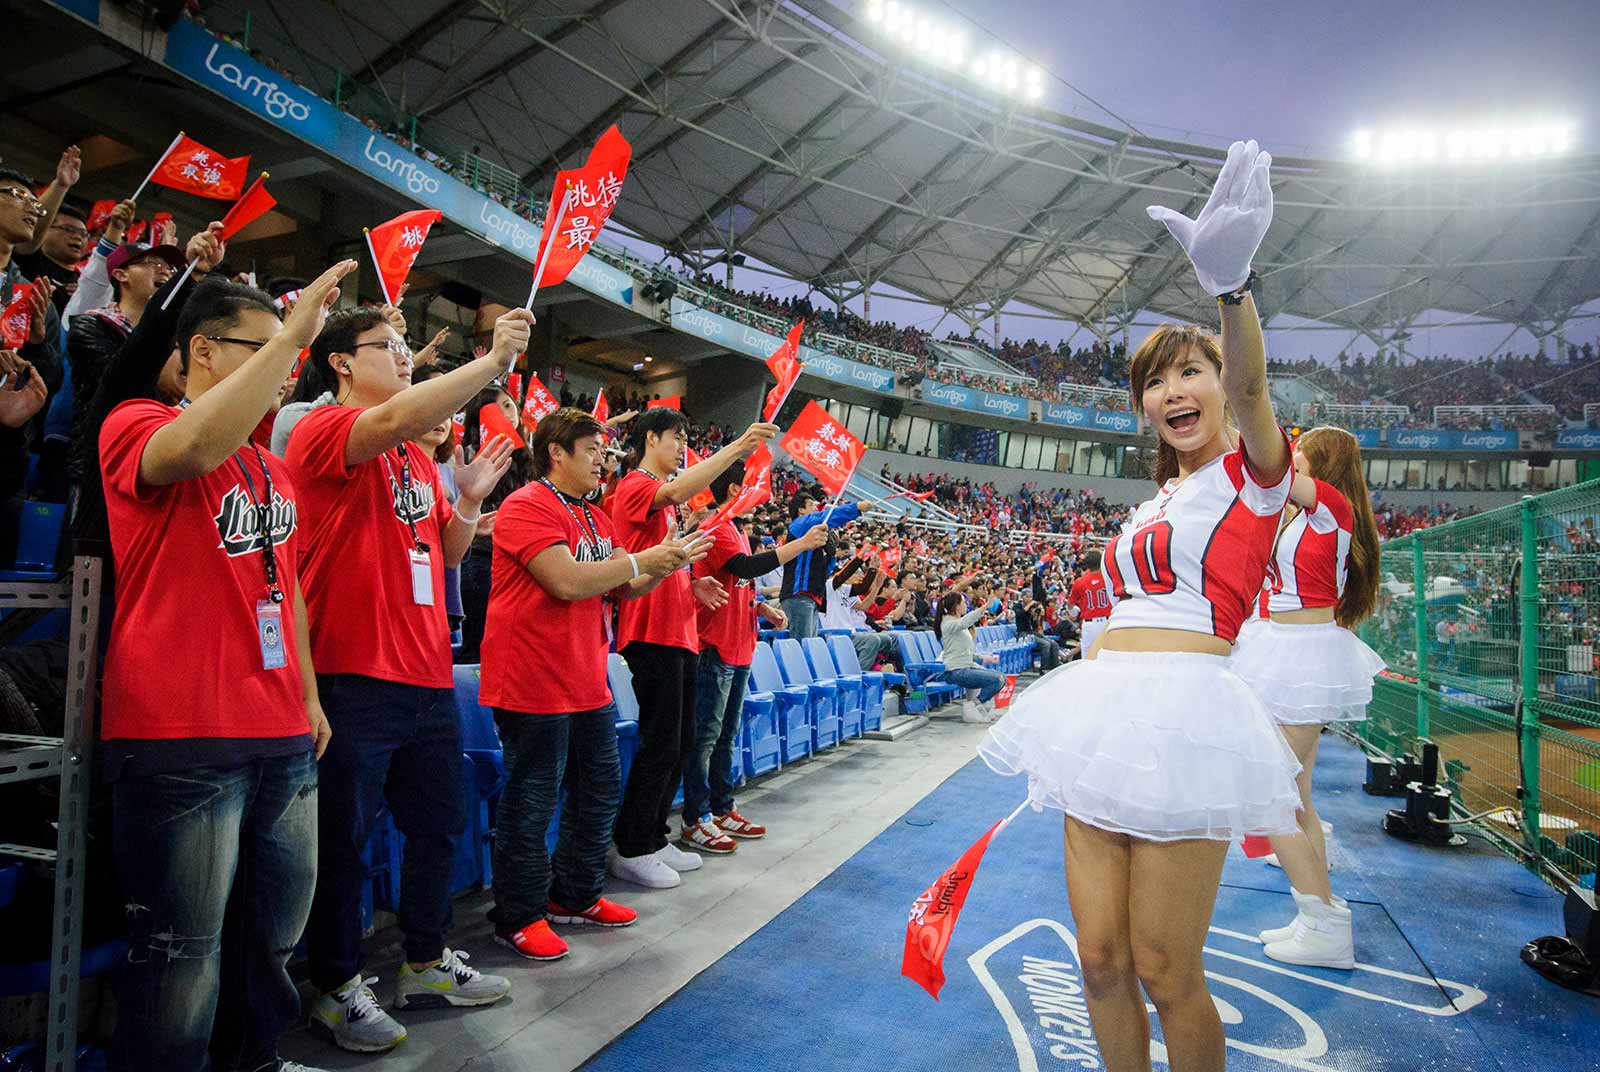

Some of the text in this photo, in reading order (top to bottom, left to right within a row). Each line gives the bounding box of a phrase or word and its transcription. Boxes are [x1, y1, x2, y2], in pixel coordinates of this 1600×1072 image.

[205, 43, 310, 120] Lamigo
[365, 135, 440, 193] Lamigo
[480, 201, 537, 249] Lamigo
[562, 214, 600, 251] 最
[680, 303, 722, 335] Lamigo
[852, 365, 889, 388] Lamigo
[931, 383, 966, 405] Lamigo
[984, 394, 1019, 414] Lamigo
[1048, 404, 1083, 424] Lamigo
[1096, 411, 1131, 430] Lamigo
[1103, 520, 1177, 601] 10
[1086, 588, 1109, 609] 10
[1018, 955, 1099, 1069] MONKEYS
